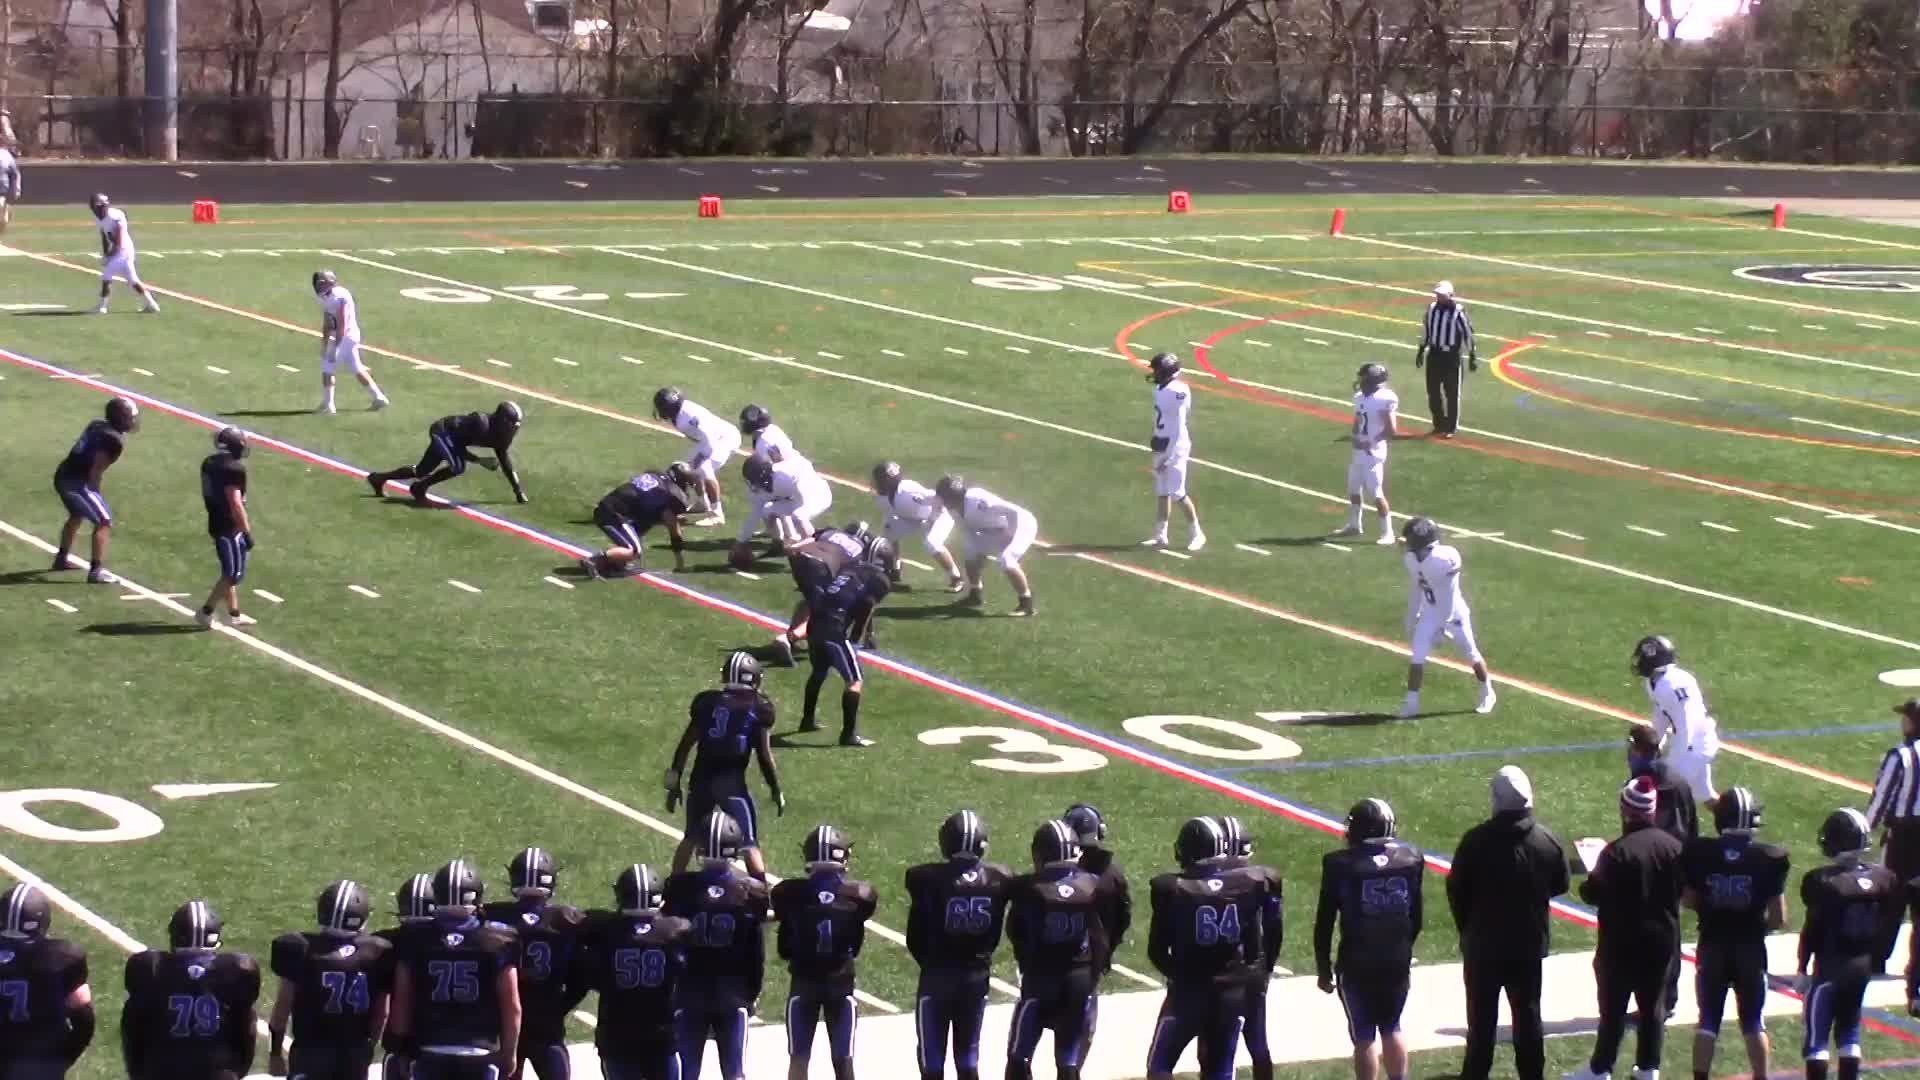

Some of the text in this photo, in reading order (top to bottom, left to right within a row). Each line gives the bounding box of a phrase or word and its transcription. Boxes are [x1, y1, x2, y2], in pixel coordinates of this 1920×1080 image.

[816, 918, 833, 953] 1
[1194, 904, 1241, 944] 64
[428, 959, 480, 1002] 75
[614, 946, 666, 988] 58
[322, 971, 370, 1014] 74
[167, 994, 220, 1037] 79
